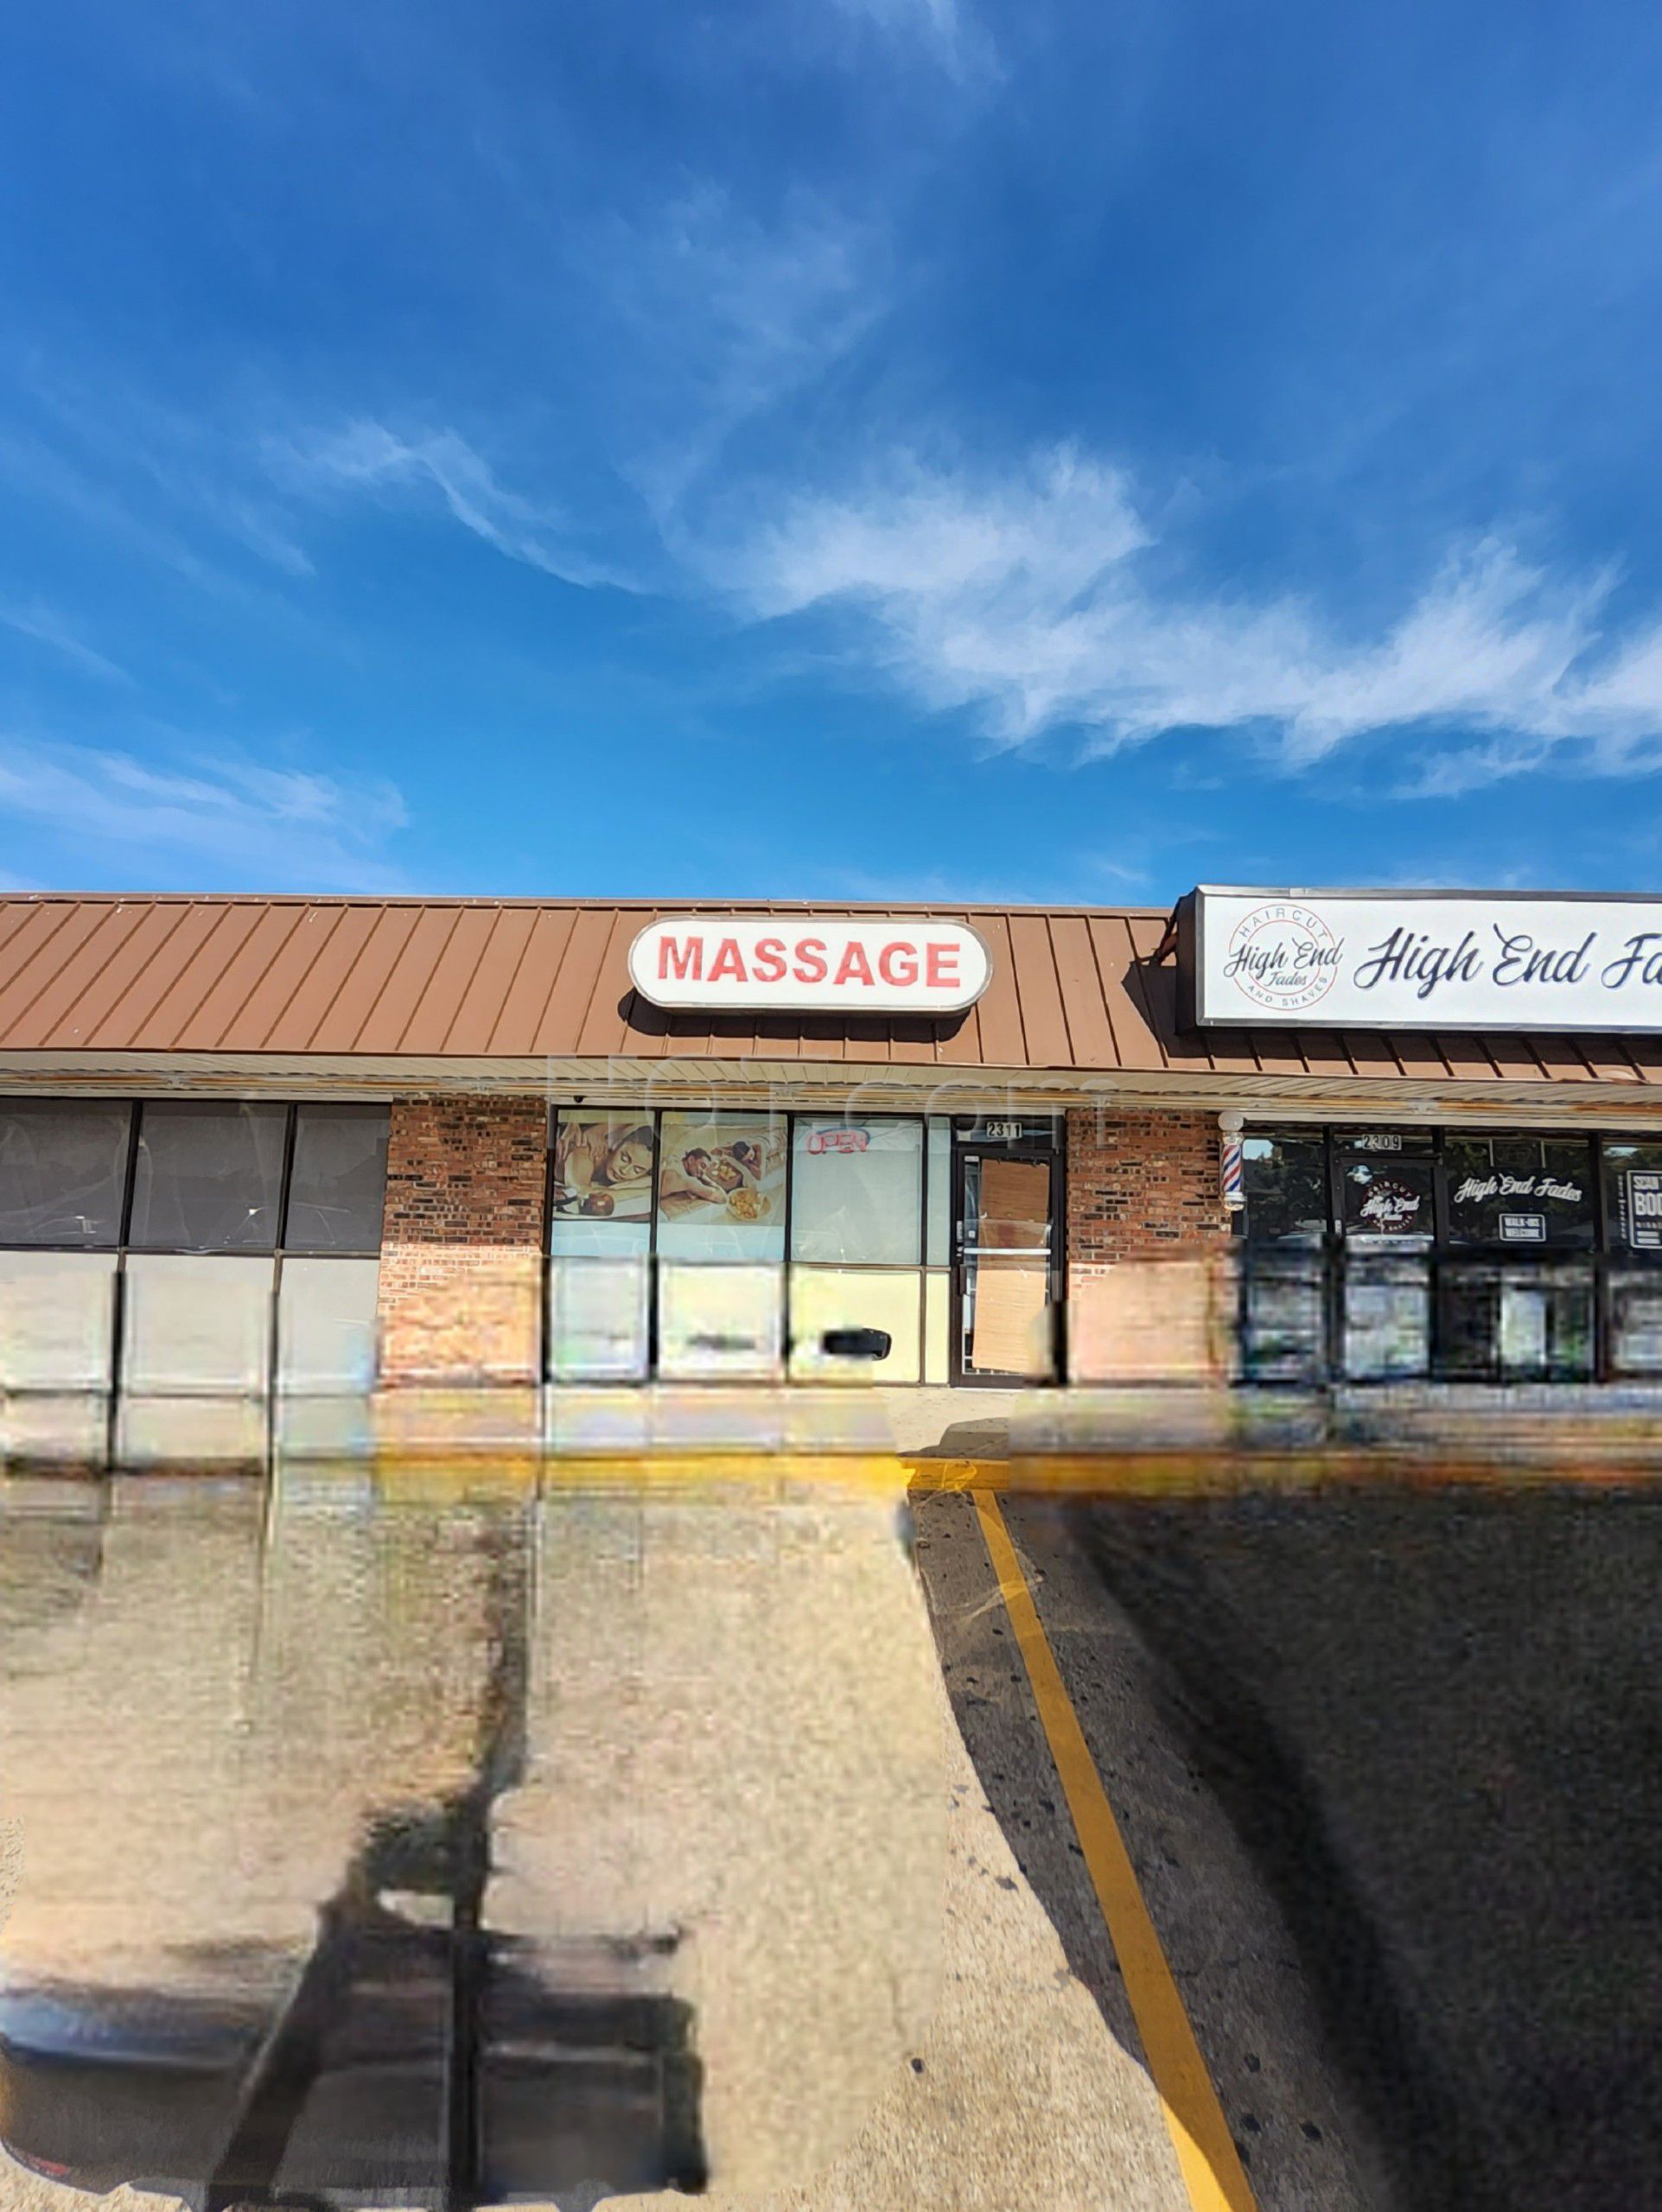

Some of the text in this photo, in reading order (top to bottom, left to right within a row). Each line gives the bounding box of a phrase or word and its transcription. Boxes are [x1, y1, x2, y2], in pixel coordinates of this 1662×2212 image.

[1239, 908, 1328, 938] HAIRCUT
[658, 936, 961, 988] MASSAGE
[1223, 937, 1345, 981] High End
[1353, 927, 1484, 1000] High
[1493, 923, 1597, 987] End
[1248, 976, 1328, 1007] AND SHAVES
[1264, 971, 1308, 987] Fades
[806, 1130, 867, 1154] OPEN
[988, 1122, 1021, 1137] 2311
[1363, 1135, 1400, 1149] 2309
[1454, 1173, 1582, 1204] High End Fades
